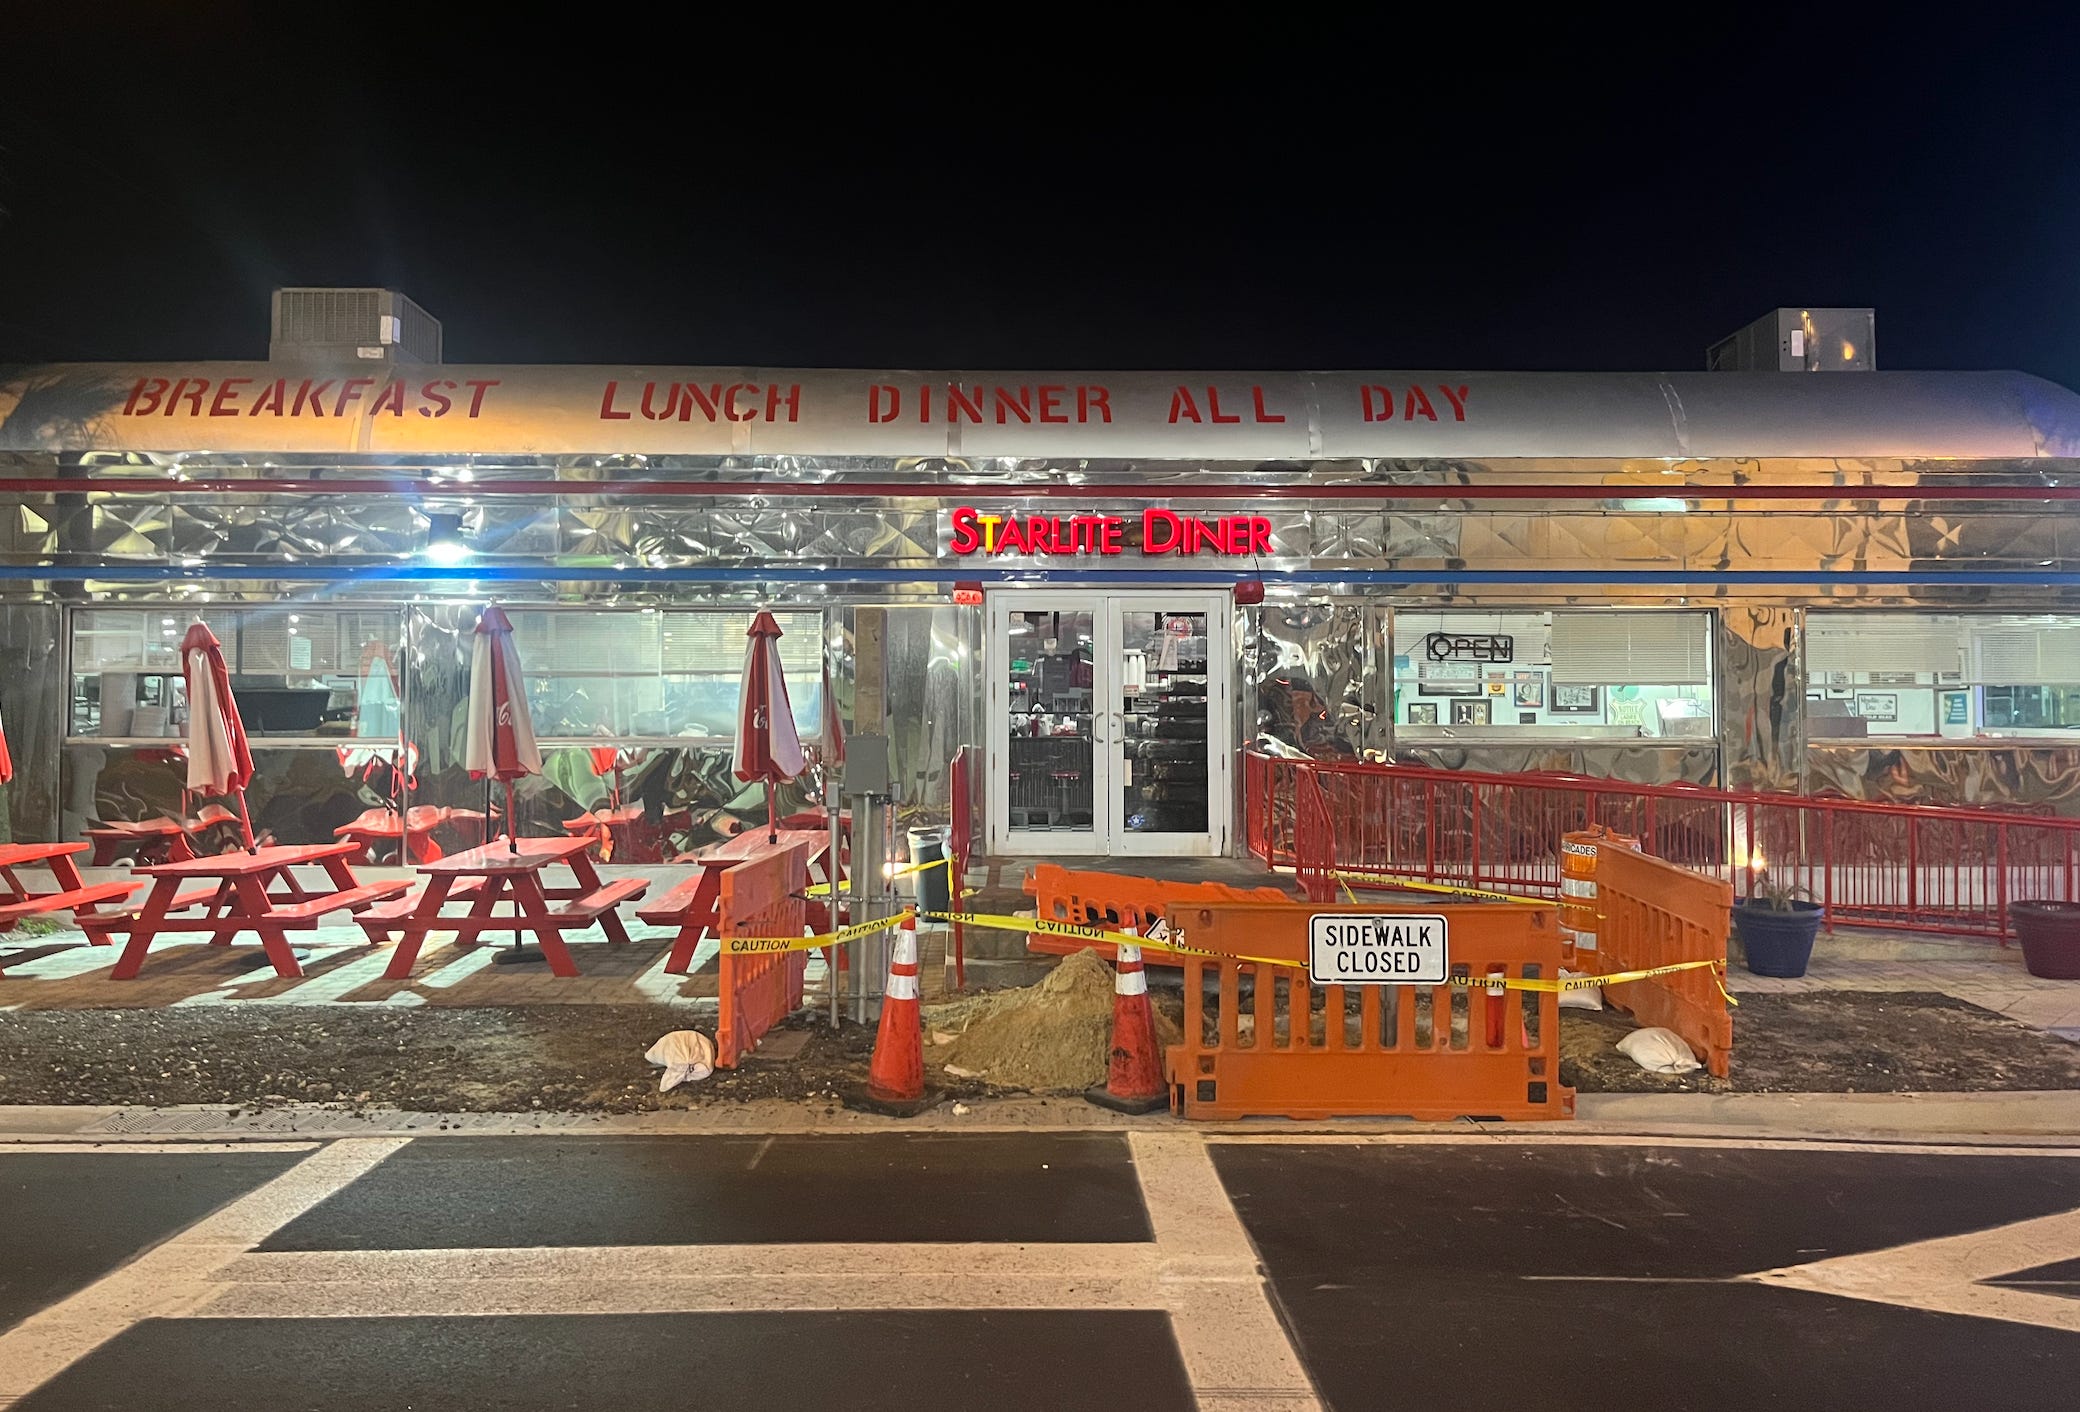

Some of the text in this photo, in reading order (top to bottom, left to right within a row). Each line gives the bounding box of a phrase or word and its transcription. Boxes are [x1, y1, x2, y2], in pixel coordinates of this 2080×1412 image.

[123, 377, 1469, 425] BREAKFAST LUNCH DINNER ALL DAY
[951, 506, 1275, 555] STARLITE DINER
[1431, 637, 1508, 659] OPEN
[836, 919, 889, 942] CAUTION
[1325, 925, 1432, 947] SIDEWALK
[730, 940, 791, 952] CAUTION
[1337, 951, 1421, 973] CLOSED
[1565, 977, 1610, 991] CAUTION
